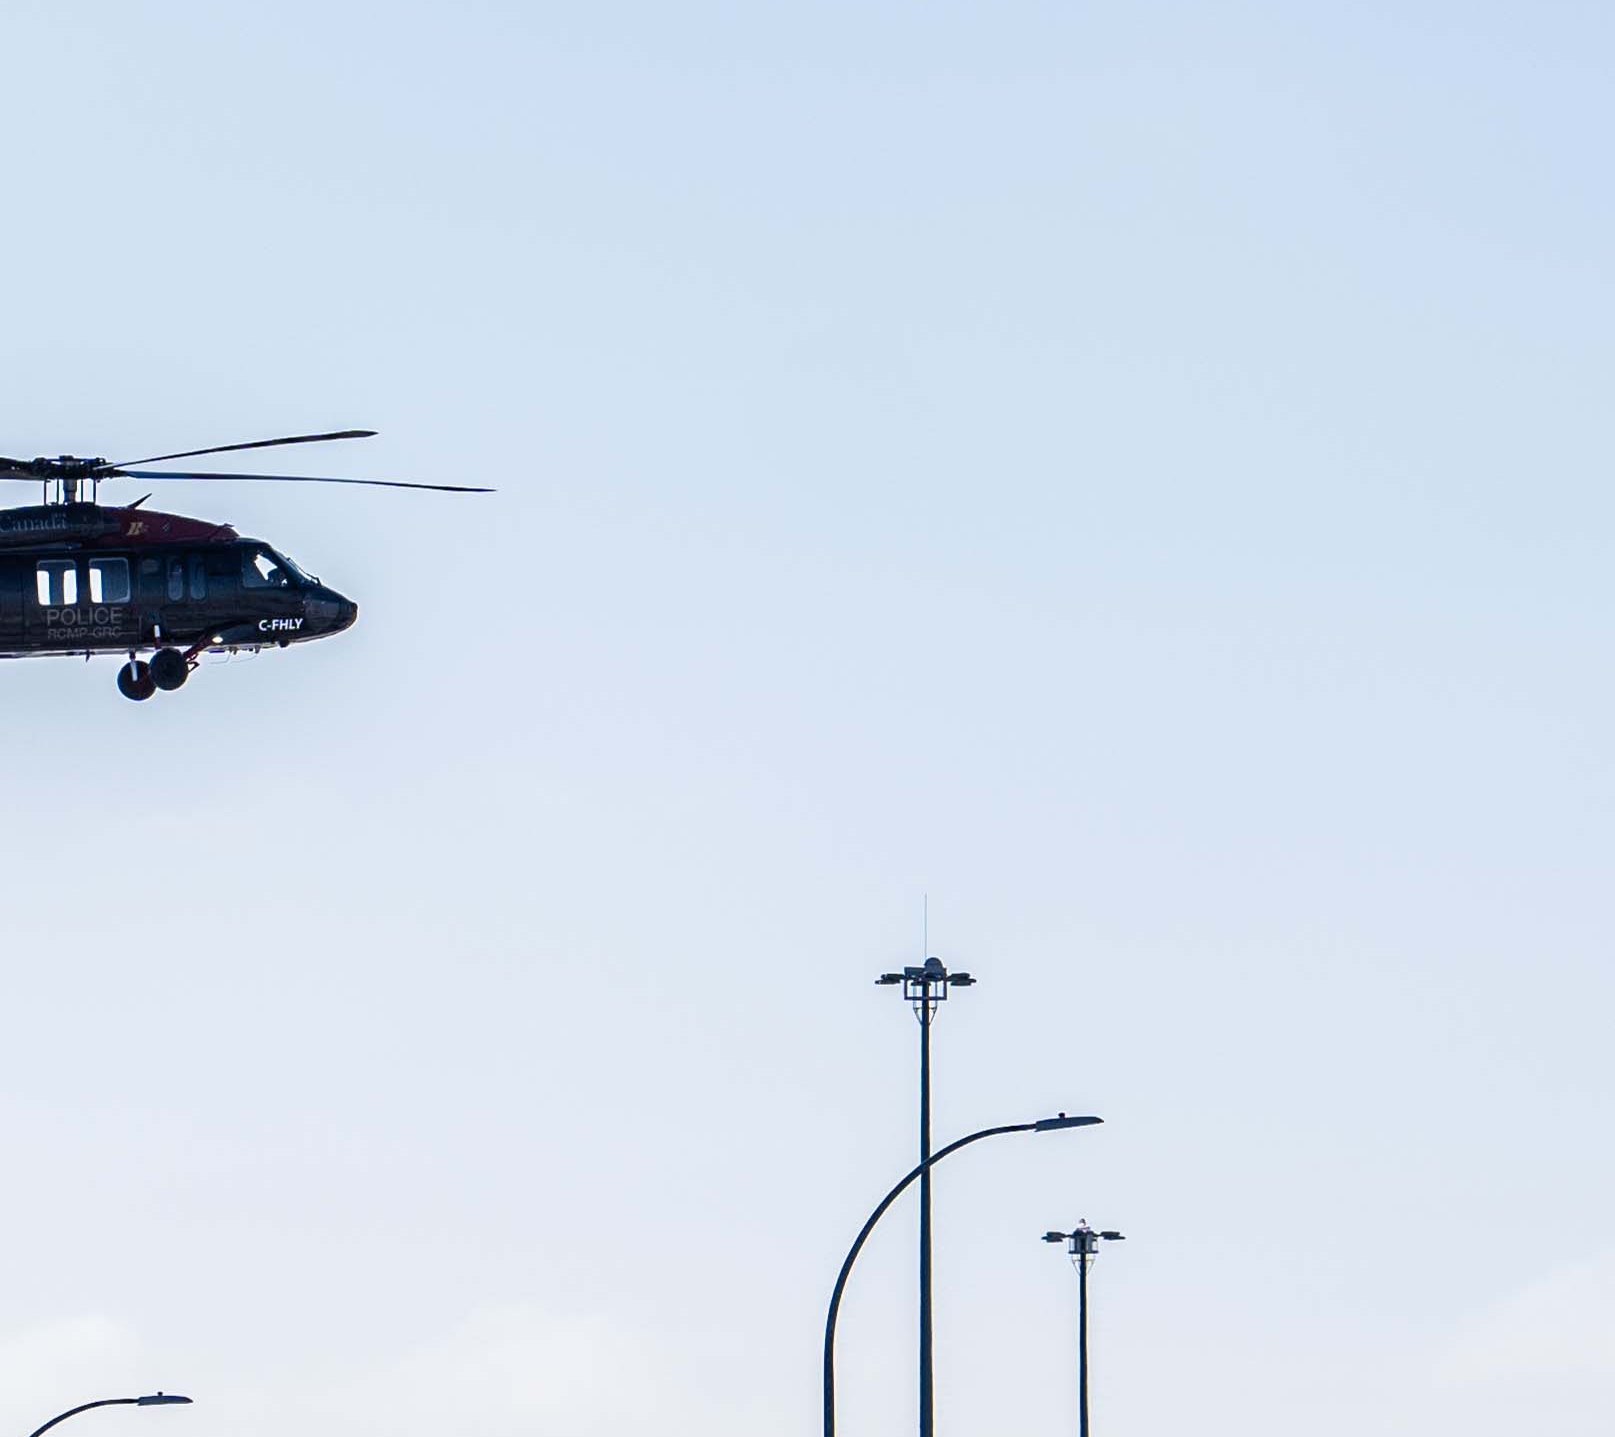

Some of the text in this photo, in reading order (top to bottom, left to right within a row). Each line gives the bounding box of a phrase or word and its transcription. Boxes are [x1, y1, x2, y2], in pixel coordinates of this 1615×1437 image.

[47, 607, 122, 626] POLICE
[258, 618, 304, 632] C-FHLY
[48, 626, 122, 640] RCMP-GRC
